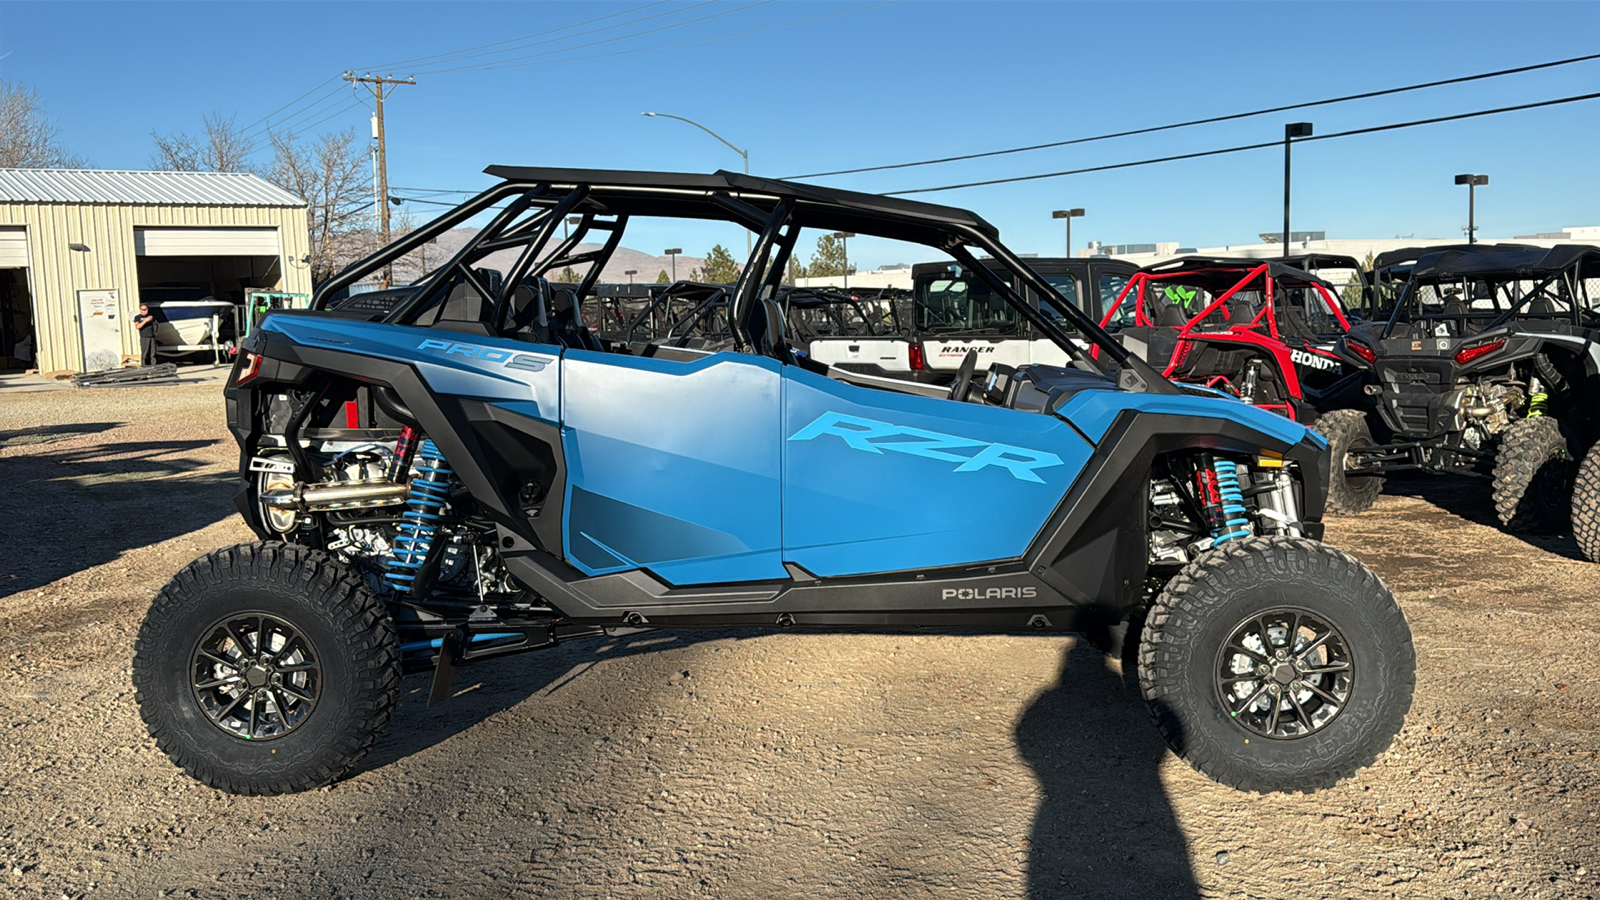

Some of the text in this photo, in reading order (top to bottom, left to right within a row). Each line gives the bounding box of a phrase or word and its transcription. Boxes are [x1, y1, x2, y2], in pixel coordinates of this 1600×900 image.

[417, 339, 554, 372] PRO S
[1290, 348, 1343, 376] HONDA
[787, 410, 1065, 484] RZR
[942, 586, 1037, 600] POLARIS
